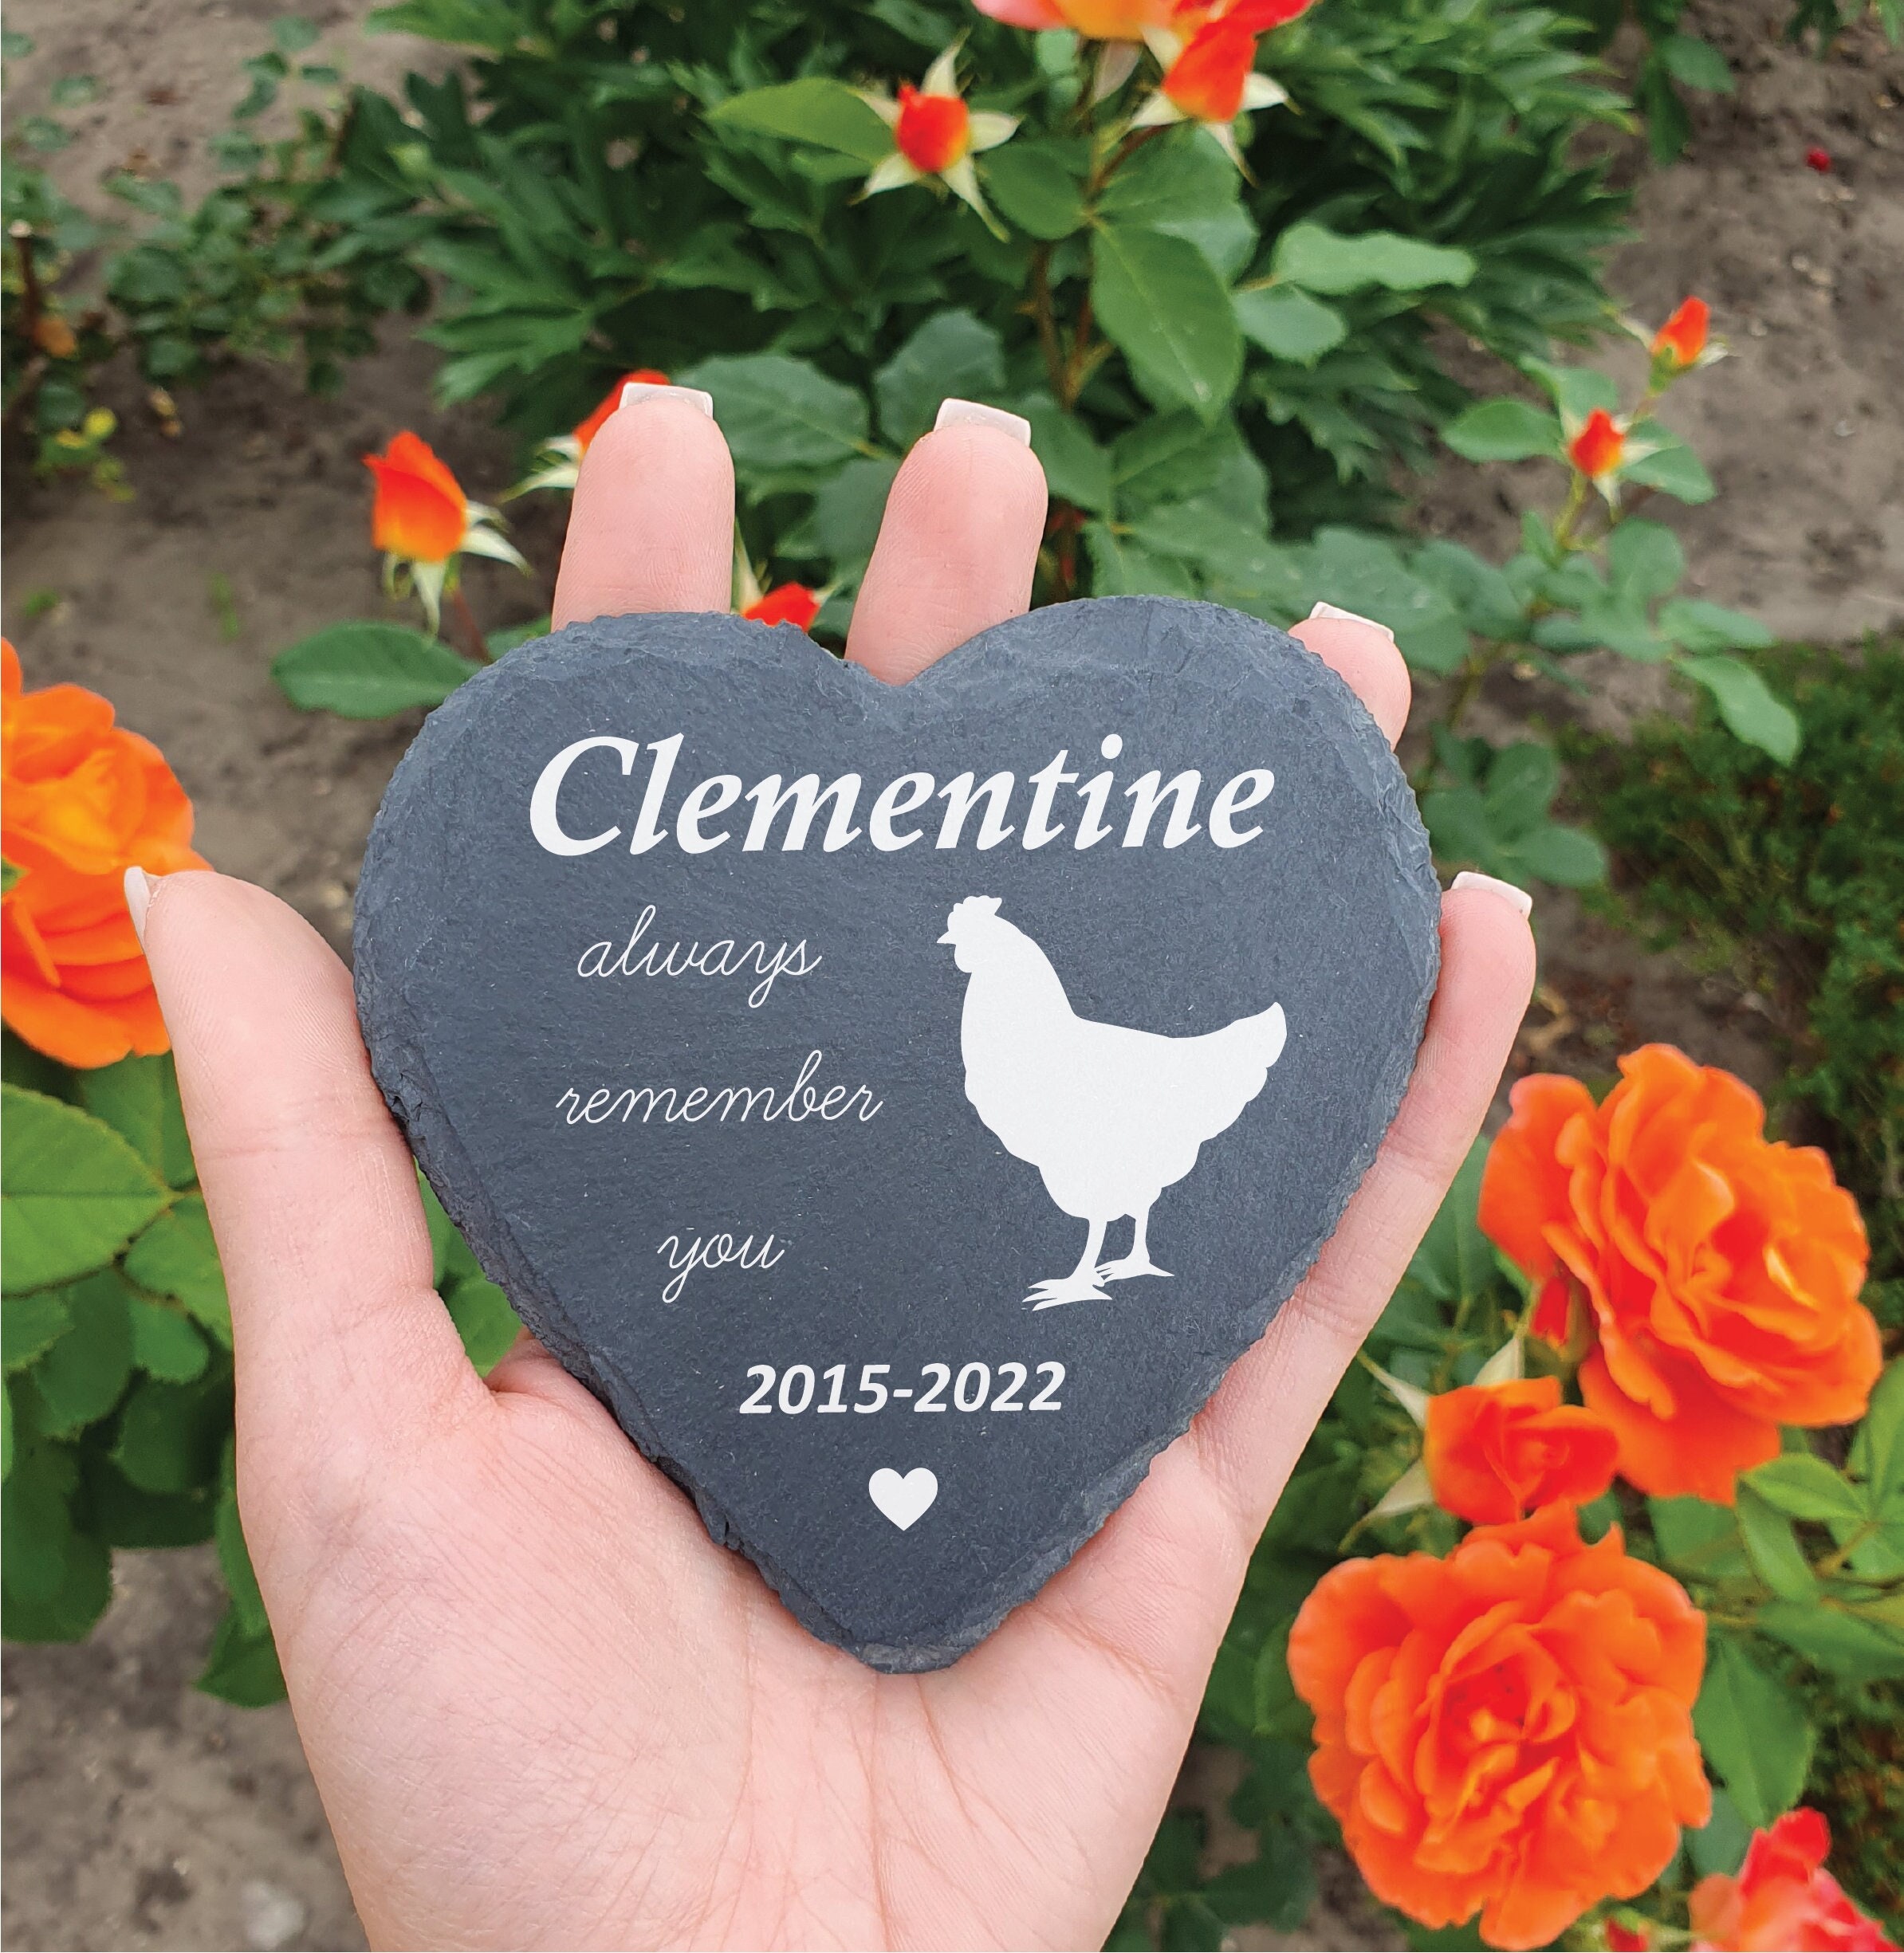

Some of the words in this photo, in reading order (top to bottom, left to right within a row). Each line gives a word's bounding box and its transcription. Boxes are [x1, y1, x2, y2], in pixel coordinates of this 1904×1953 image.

[529, 733, 1275, 856] Clementine
[576, 904, 823, 1008] always
[555, 1049, 883, 1125] remember
[656, 1232, 786, 1303] you
[739, 1361, 1066, 1415] 2015-2022
